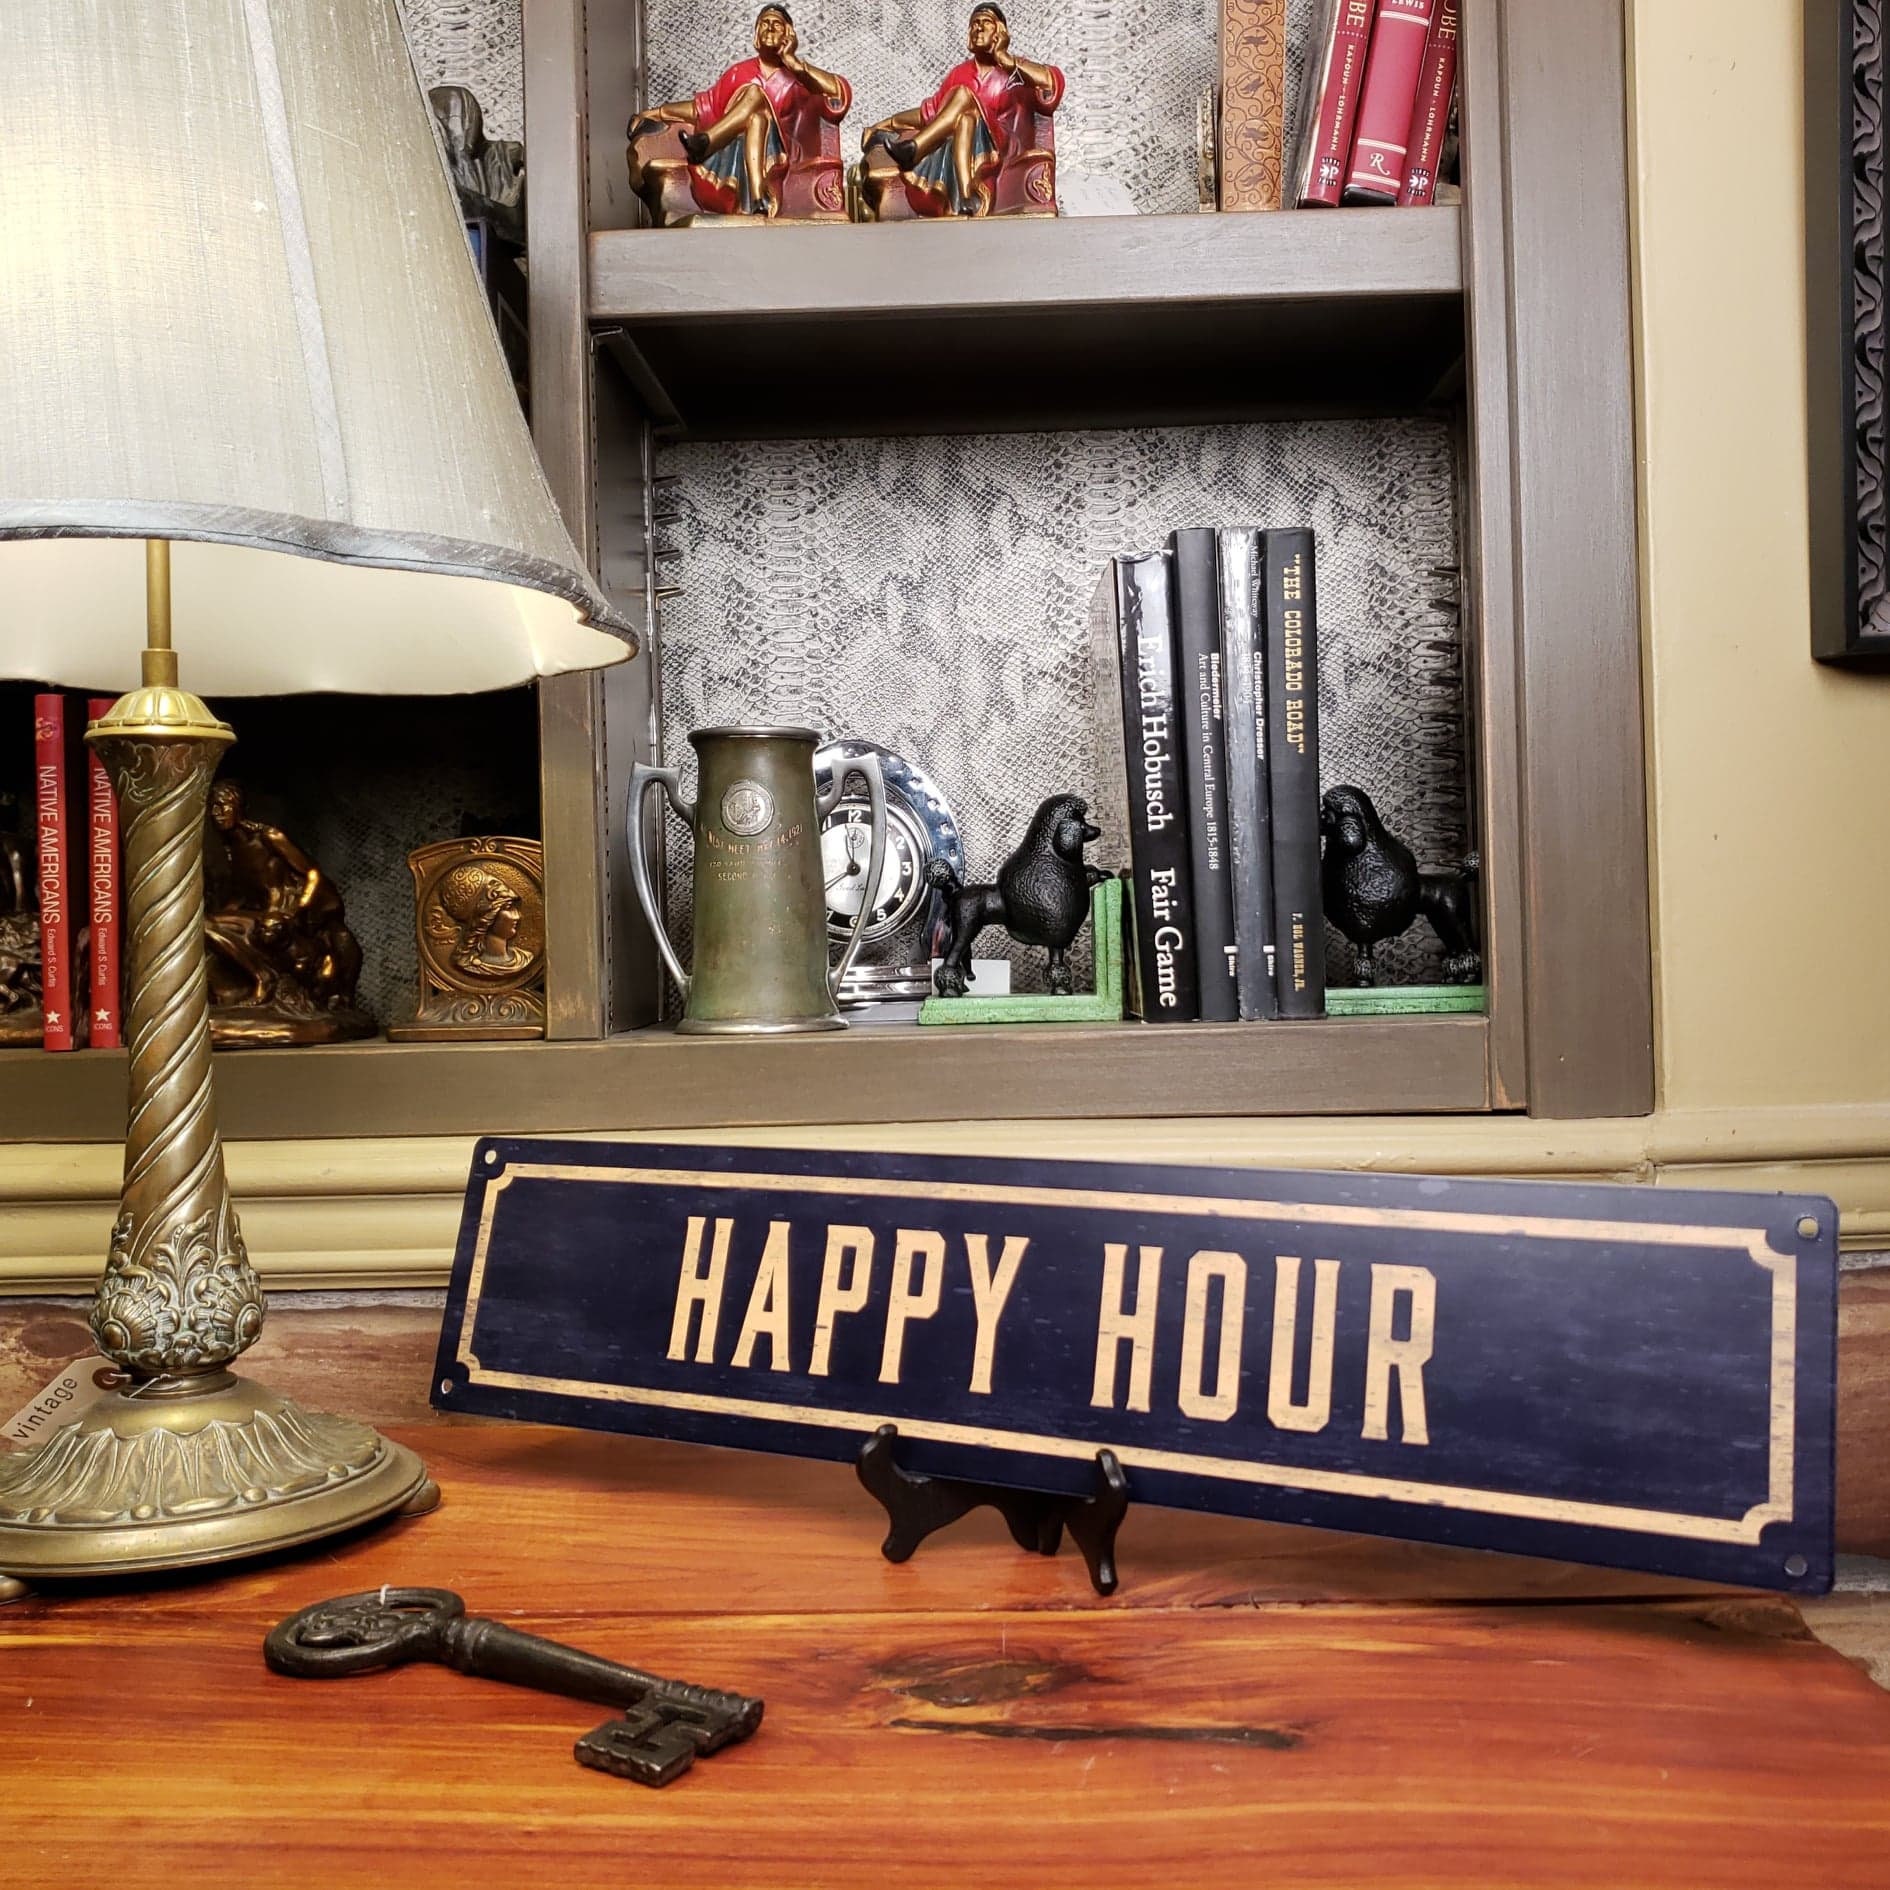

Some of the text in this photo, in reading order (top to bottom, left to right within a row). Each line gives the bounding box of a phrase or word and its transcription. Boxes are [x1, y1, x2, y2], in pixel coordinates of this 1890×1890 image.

[1330, 44, 1356, 151] KAPOUN LOHRMANN
[1420, 57, 1446, 162] KAPOUN LOHRMANN
[1369, 152, 1391, 176] R
[1284, 610, 1303, 692] COLORADO
[1210, 652, 1221, 720] Biedermeier
[1253, 651, 1265, 761] Christopher Dresser
[1137, 635, 1174, 832] Erich Hobusch
[1198, 652, 1220, 870] Art and Culture in Central Europe 1815-1848
[39, 765, 58, 823] NATIVE
[93, 767, 112, 824] NATIVE
[848, 809, 862, 823] 12
[895, 836, 905, 850] 2
[901, 861, 912, 876] 3
[40, 826, 61, 924] AMERICANS
[93, 826, 113, 924] AMERICANS
[894, 887, 905, 903] 4
[47, 928, 57, 956] Edward
[98, 927, 108, 955] Edward
[876, 908, 887, 922] 5
[1150, 867, 1184, 1007] Fair Game
[47, 965, 58, 988] Curtis
[98, 964, 108, 986] Curtis
[667, 1215, 1437, 1446] HAPPY HOUR
[12, 1377, 78, 1440] vintage
